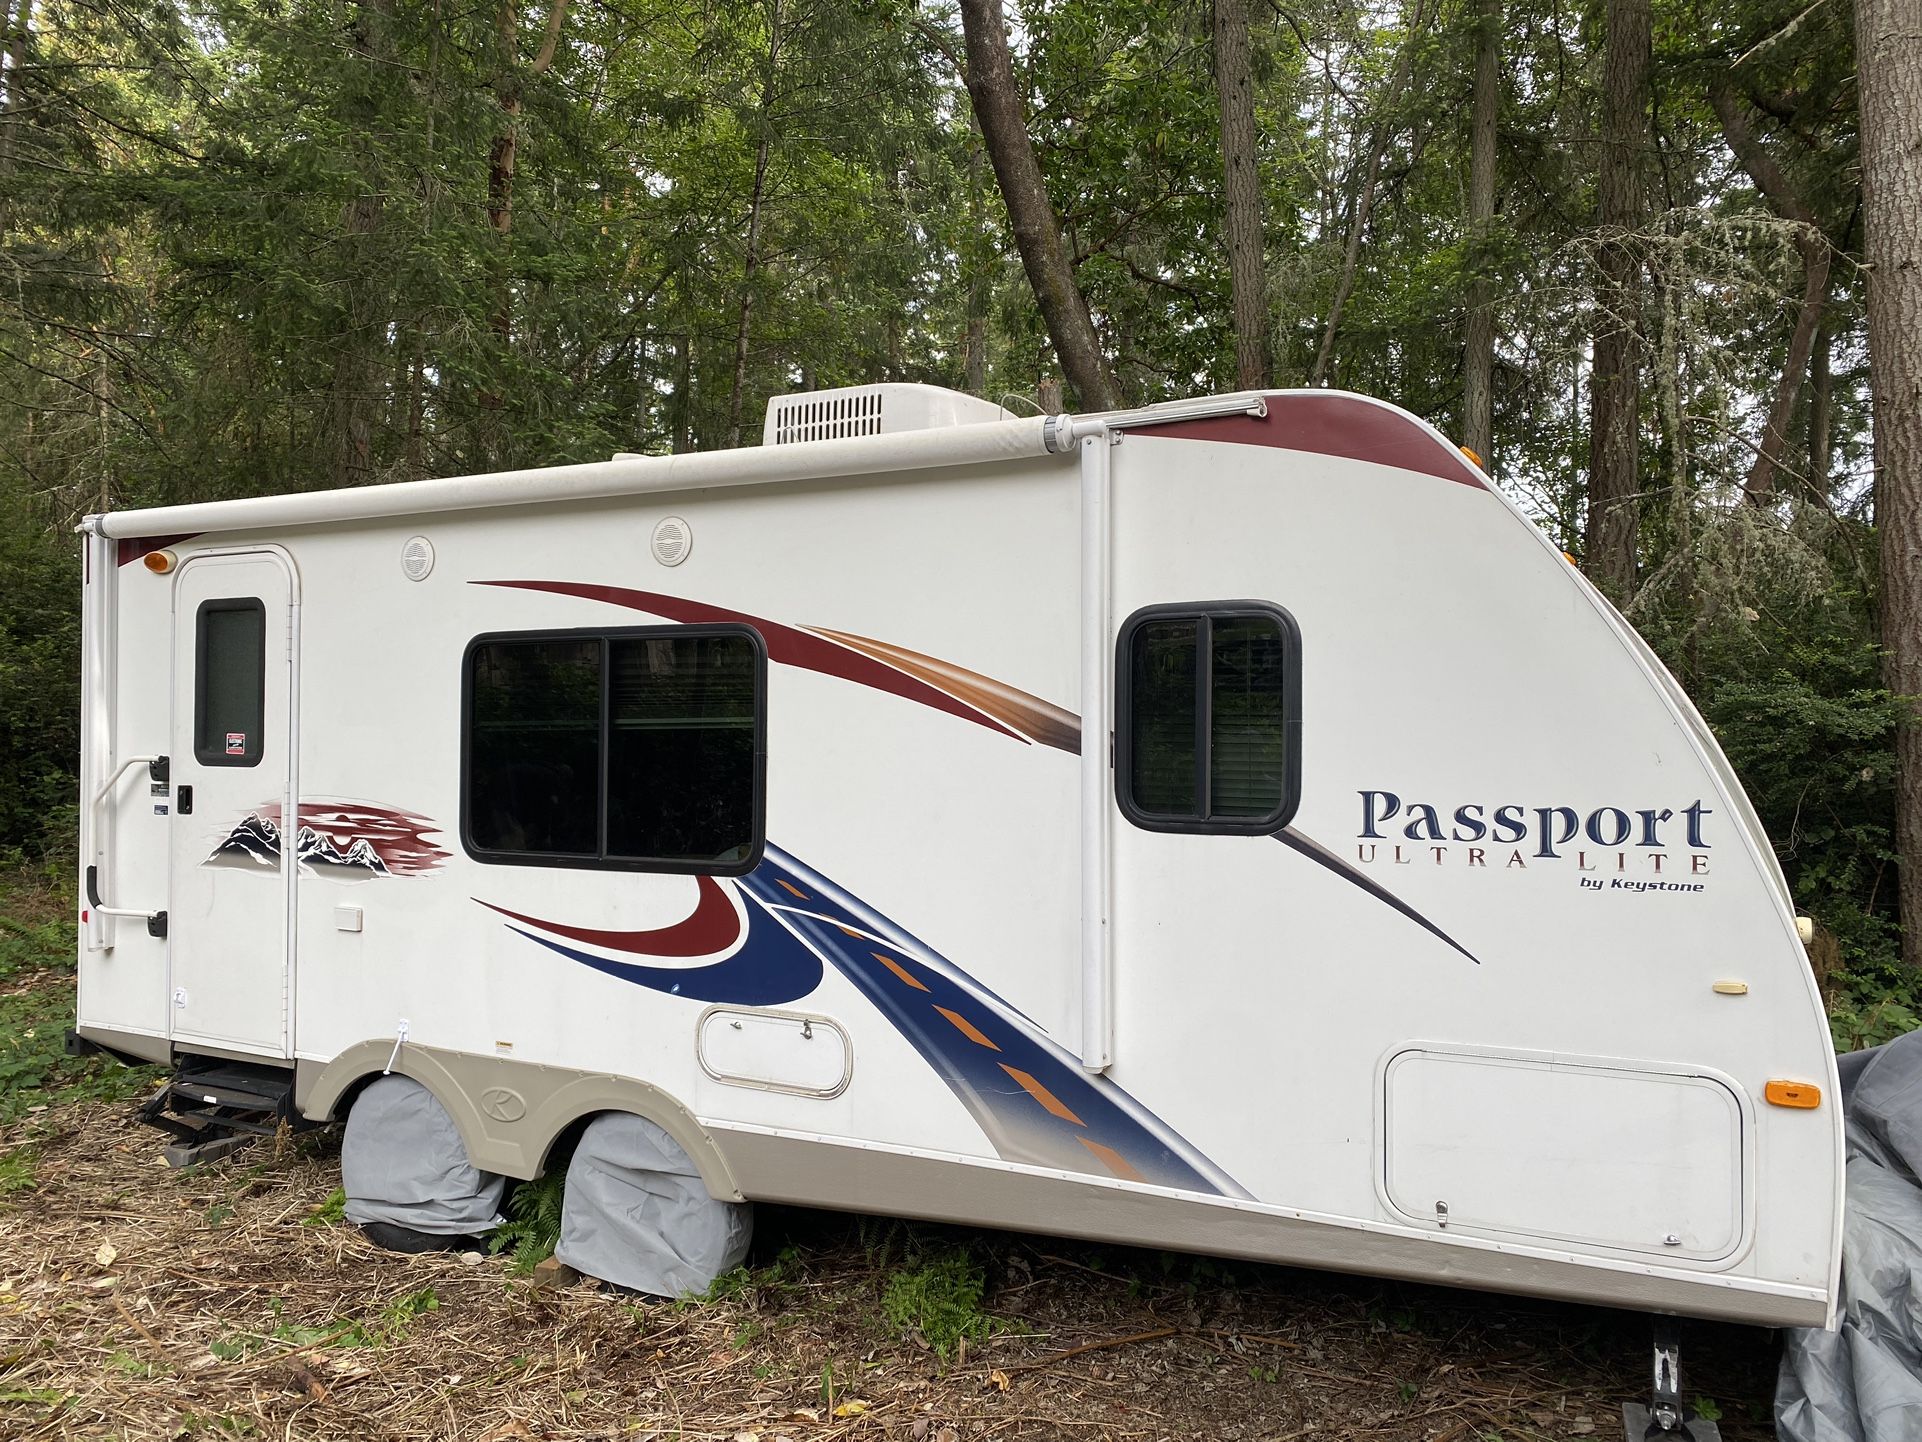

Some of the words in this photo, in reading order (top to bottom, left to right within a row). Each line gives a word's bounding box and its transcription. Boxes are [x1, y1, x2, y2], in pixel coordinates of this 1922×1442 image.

[1357, 790, 1714, 859] Passport
[1358, 844, 1528, 869] ULTRA
[1579, 851, 1711, 875] LITE
[1580, 877, 1603, 891] by
[1611, 878, 1705, 893] Keystone
